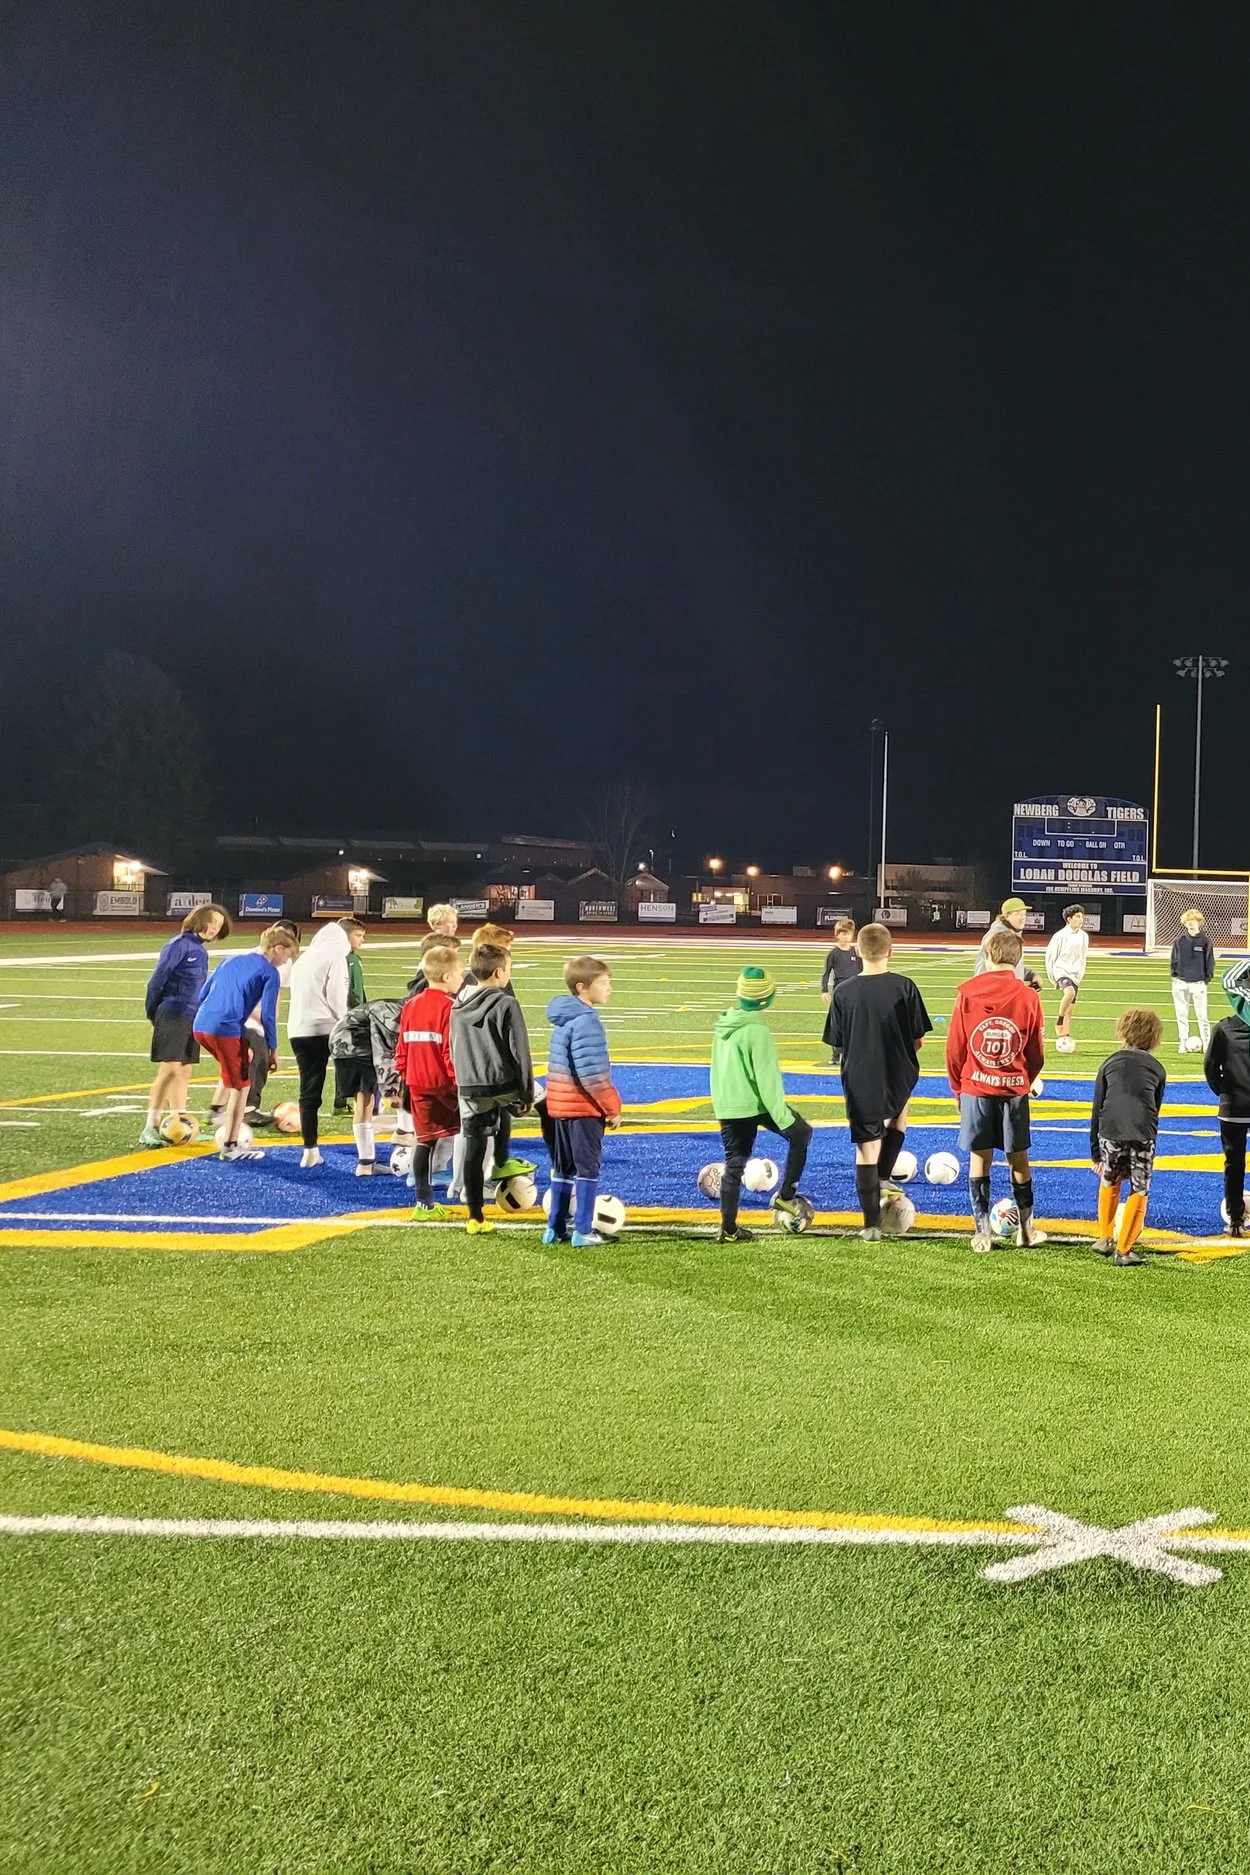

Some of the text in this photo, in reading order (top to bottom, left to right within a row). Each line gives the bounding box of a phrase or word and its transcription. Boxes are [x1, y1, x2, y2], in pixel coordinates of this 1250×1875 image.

[1014, 804, 1144, 819] NEWBERG TIGERS
[1058, 869, 1108, 881] DOUGLAS
[1110, 871, 1139, 882] FIELD
[640, 904, 674, 912] HENSON
[995, 1020, 1015, 1033] OREGON
[986, 1041, 1007, 1054] 101
[975, 1051, 996, 1066] ALWAYS
[971, 1071, 1025, 1086] ALWAYS FRESH
